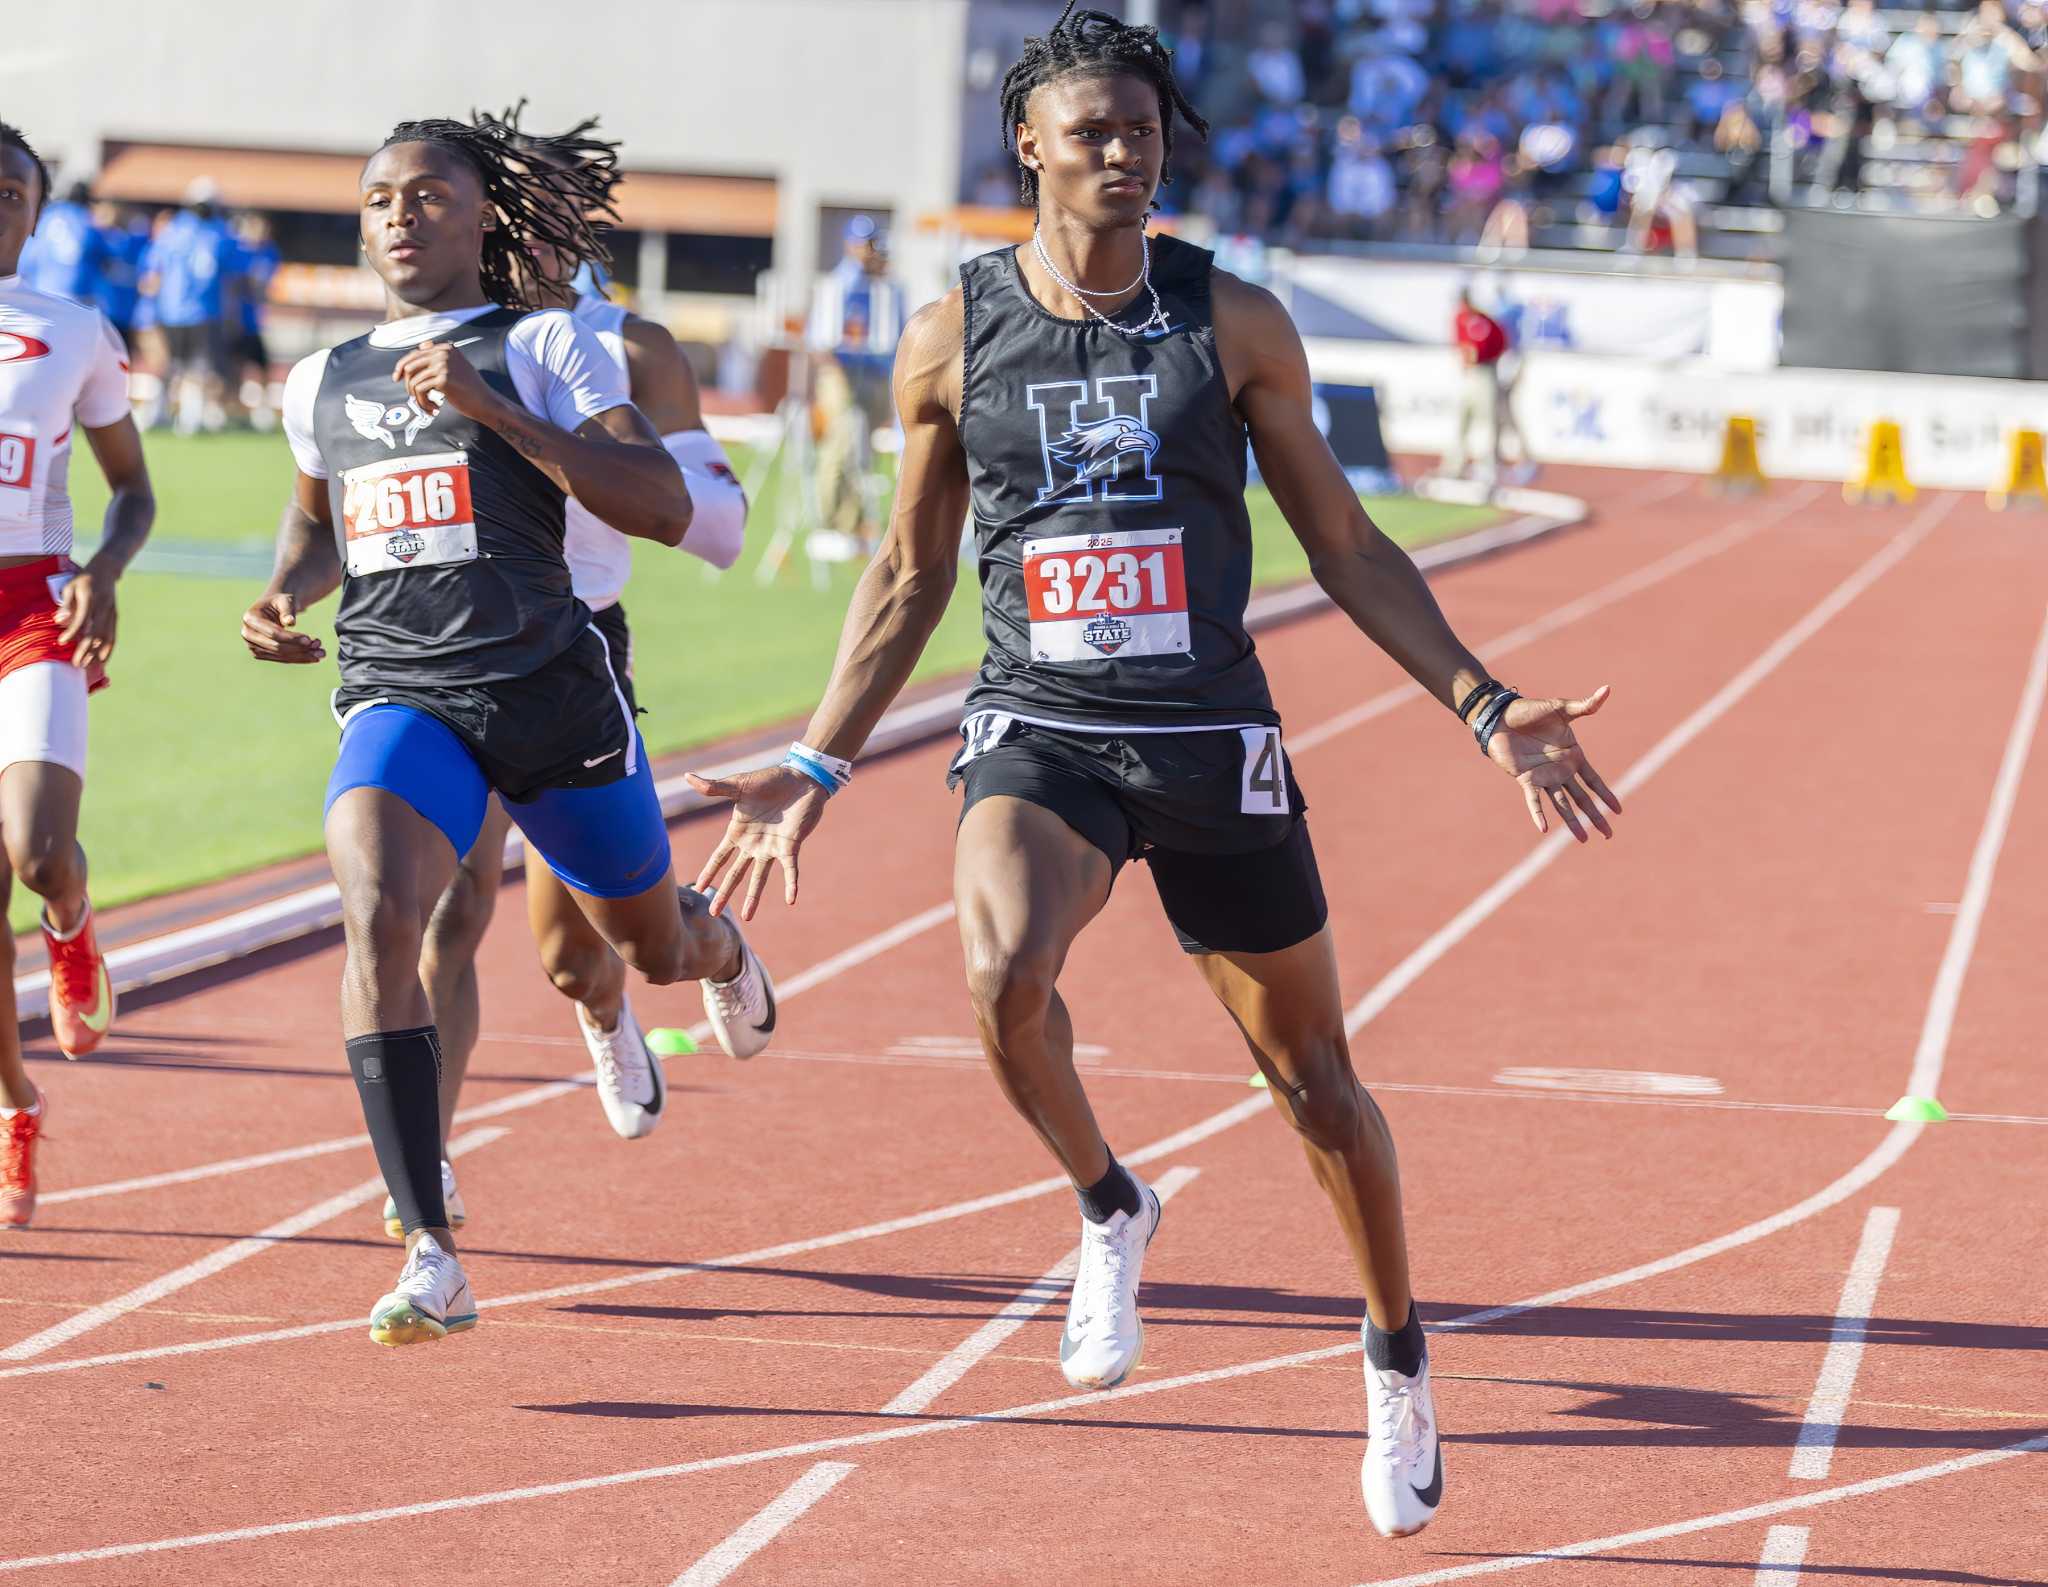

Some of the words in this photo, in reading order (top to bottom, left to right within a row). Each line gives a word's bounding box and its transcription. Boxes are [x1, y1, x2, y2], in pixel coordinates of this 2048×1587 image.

[355, 471, 457, 533] 2616
[386, 541, 425, 554] STATE
[1039, 551, 1168, 614] 3231
[1083, 628, 1131, 642] STATE
[1249, 732, 1281, 808] 4
